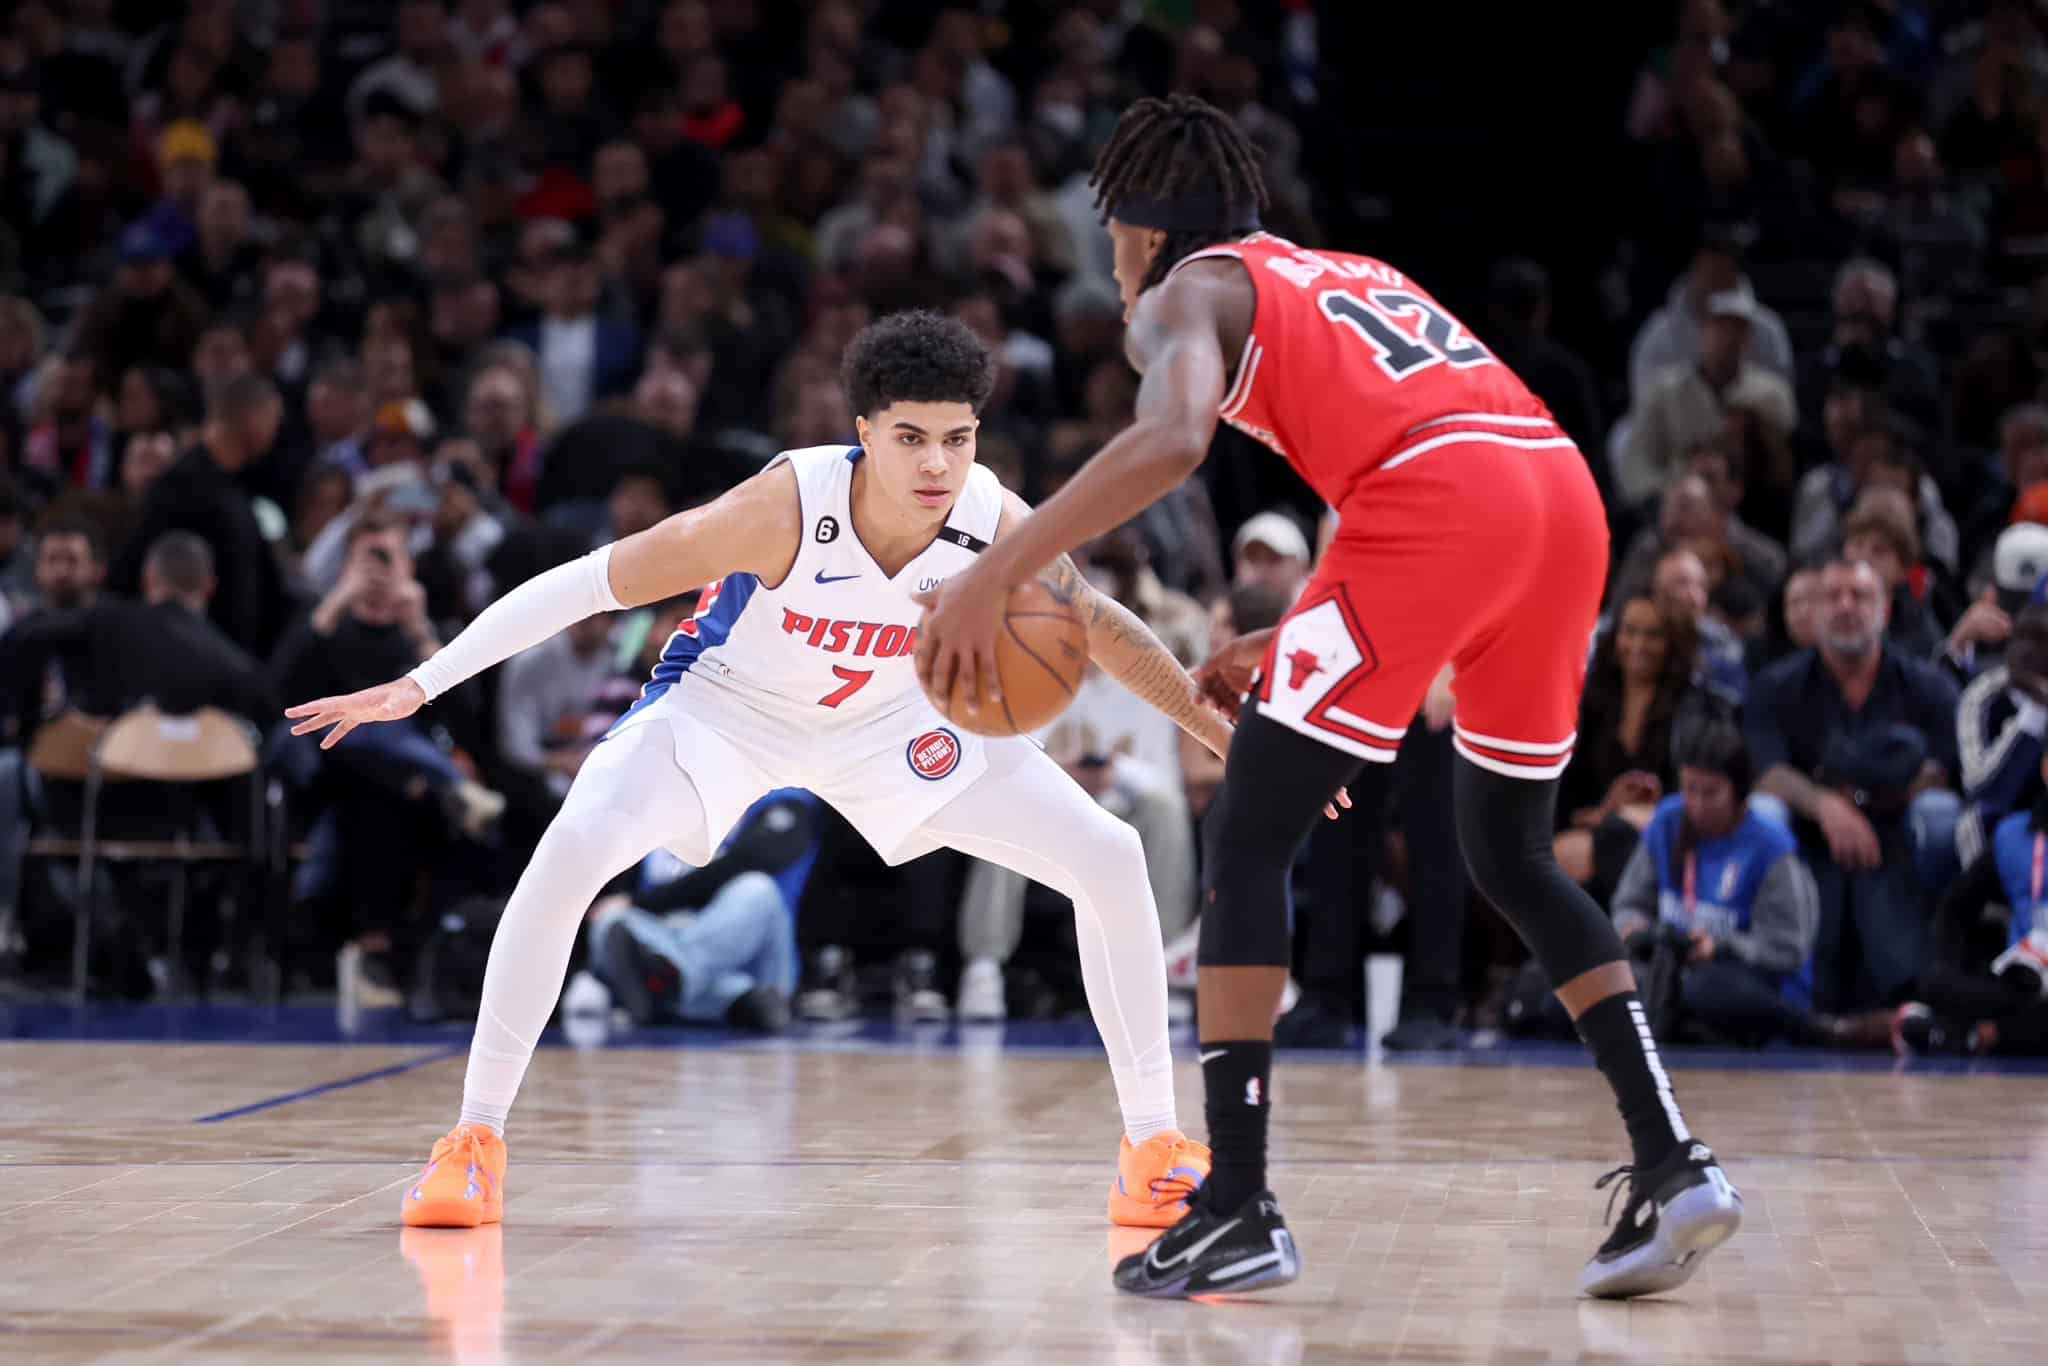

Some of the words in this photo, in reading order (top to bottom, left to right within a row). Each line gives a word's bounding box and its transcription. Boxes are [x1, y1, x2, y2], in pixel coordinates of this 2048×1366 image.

[1317, 288, 1497, 382] 12
[817, 519, 834, 541] 6
[957, 533, 971, 548] 16
[919, 576, 945, 592] UW
[817, 664, 875, 709] 7
[916, 737, 947, 762] DETROIT
[921, 745, 953, 769] PISTONS
